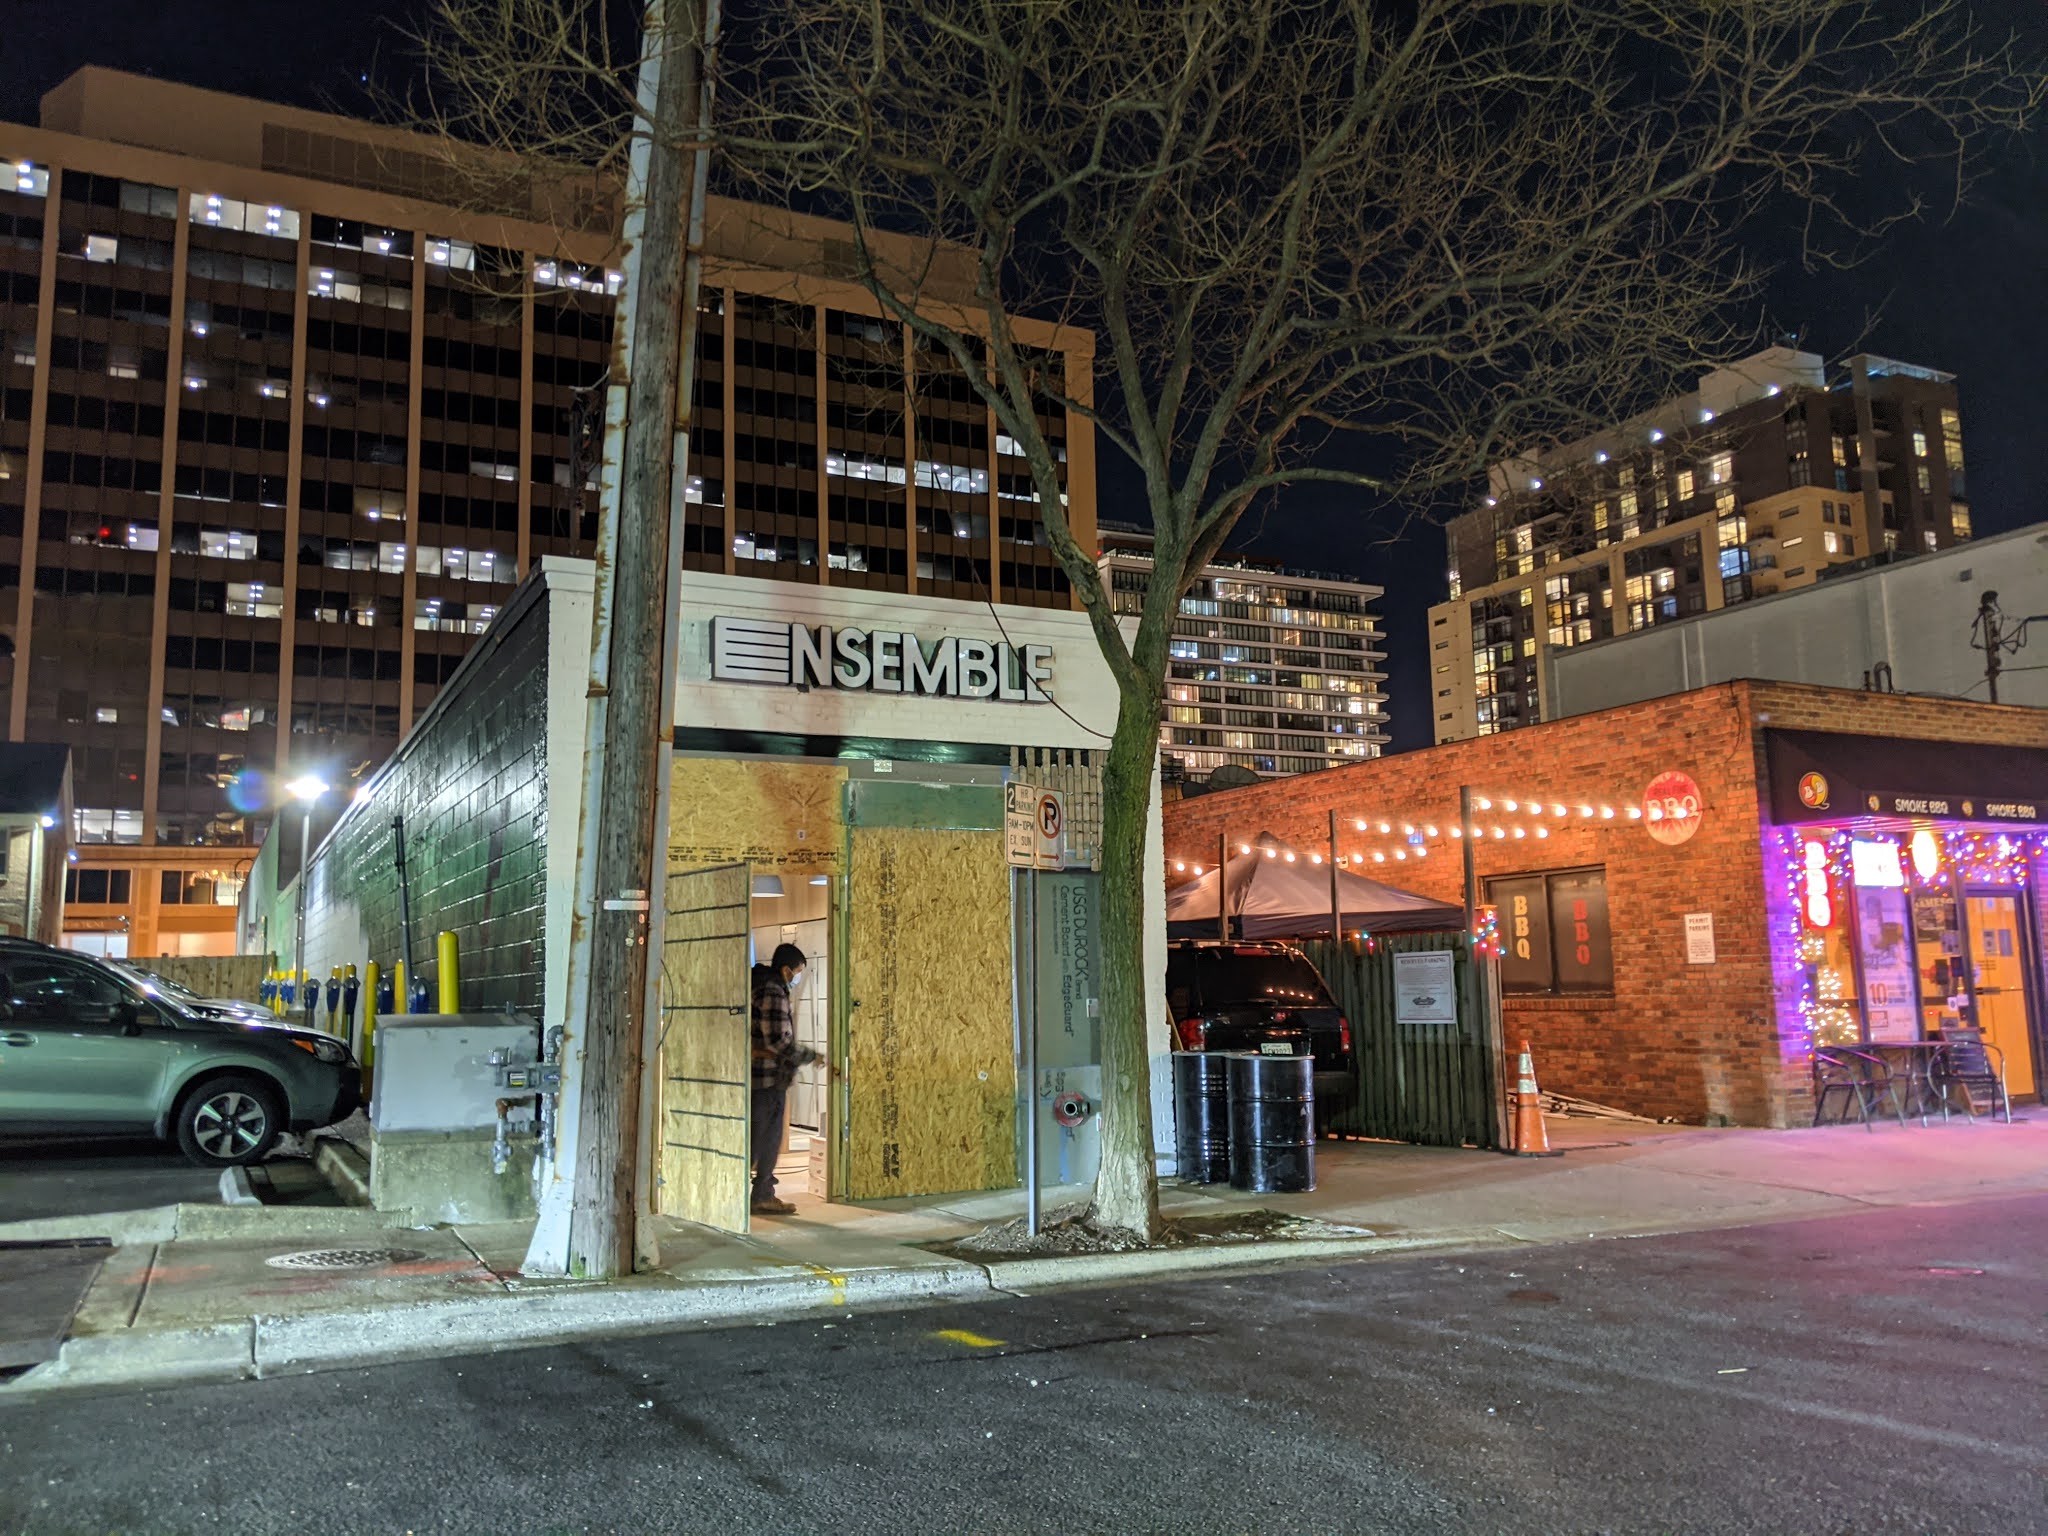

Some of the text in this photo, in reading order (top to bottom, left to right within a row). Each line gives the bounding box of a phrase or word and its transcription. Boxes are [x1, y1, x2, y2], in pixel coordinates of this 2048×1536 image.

[711, 616, 1054, 704] ENSEMBLE
[1008, 788, 1029, 809] 2 HR
[1647, 795, 1700, 822] BBQ
[1895, 799, 1928, 814] SMOKE
[1929, 800, 1949, 815] BBQ
[1986, 803, 2017, 818] SMOKE
[2017, 805, 2037, 819] BBQ
[1021, 836, 1032, 846] SUN
[1060, 885, 1070, 924] Cement
[1073, 886, 1087, 915] USG
[1062, 926, 1071, 957] Board
[1514, 895, 1530, 960] BBQ
[891, 1143, 899, 1179] APA
